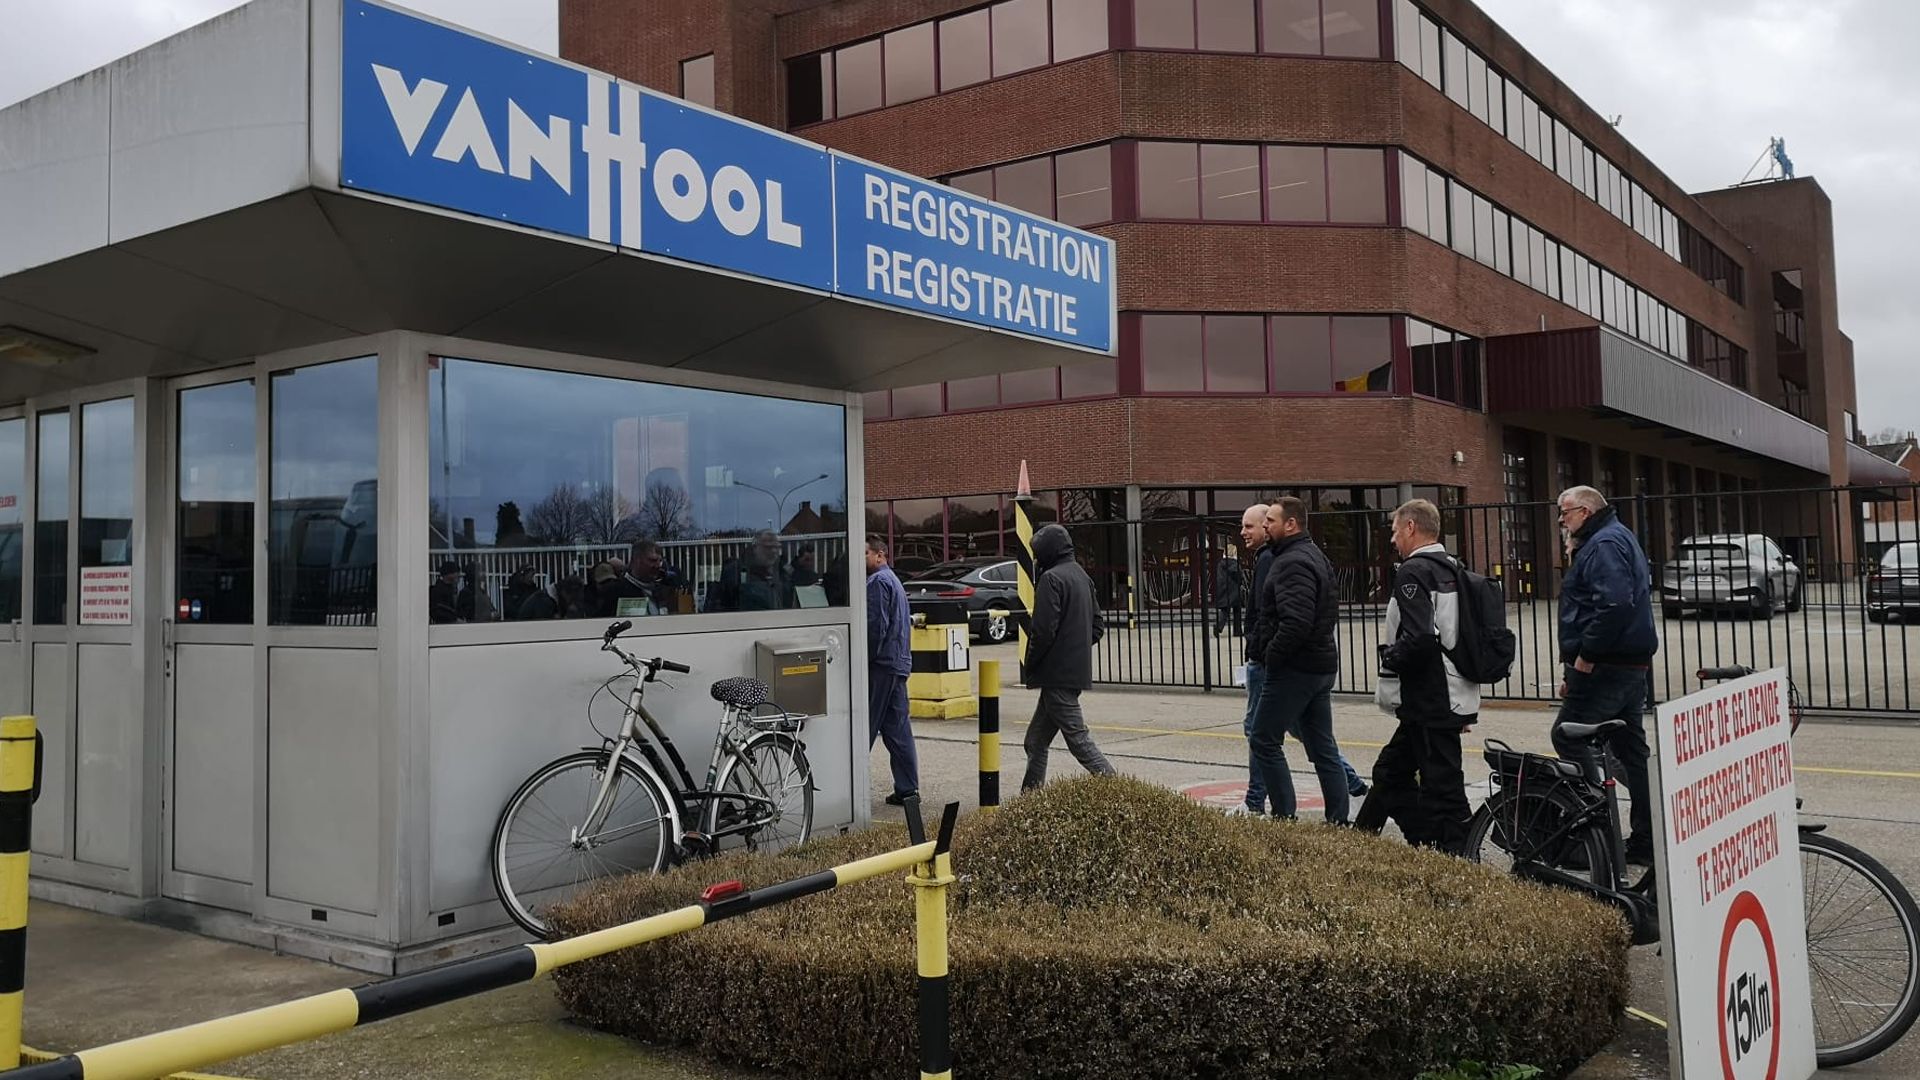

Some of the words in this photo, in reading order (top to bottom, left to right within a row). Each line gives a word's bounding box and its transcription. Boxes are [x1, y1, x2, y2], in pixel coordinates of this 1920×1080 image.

[863, 173, 1101, 283] REGISTRATION
[865, 244, 1077, 336] REGISTRATIE
[1673, 702, 1716, 767] GELIEVE
[1716, 696, 1732, 745] DE
[1732, 680, 1781, 741] GELDENDE
[1670, 740, 1793, 845] VERKEERSREGLEMENTEN
[1696, 852, 1711, 906] TE
[1711, 811, 1780, 897] RESPECTEREN
